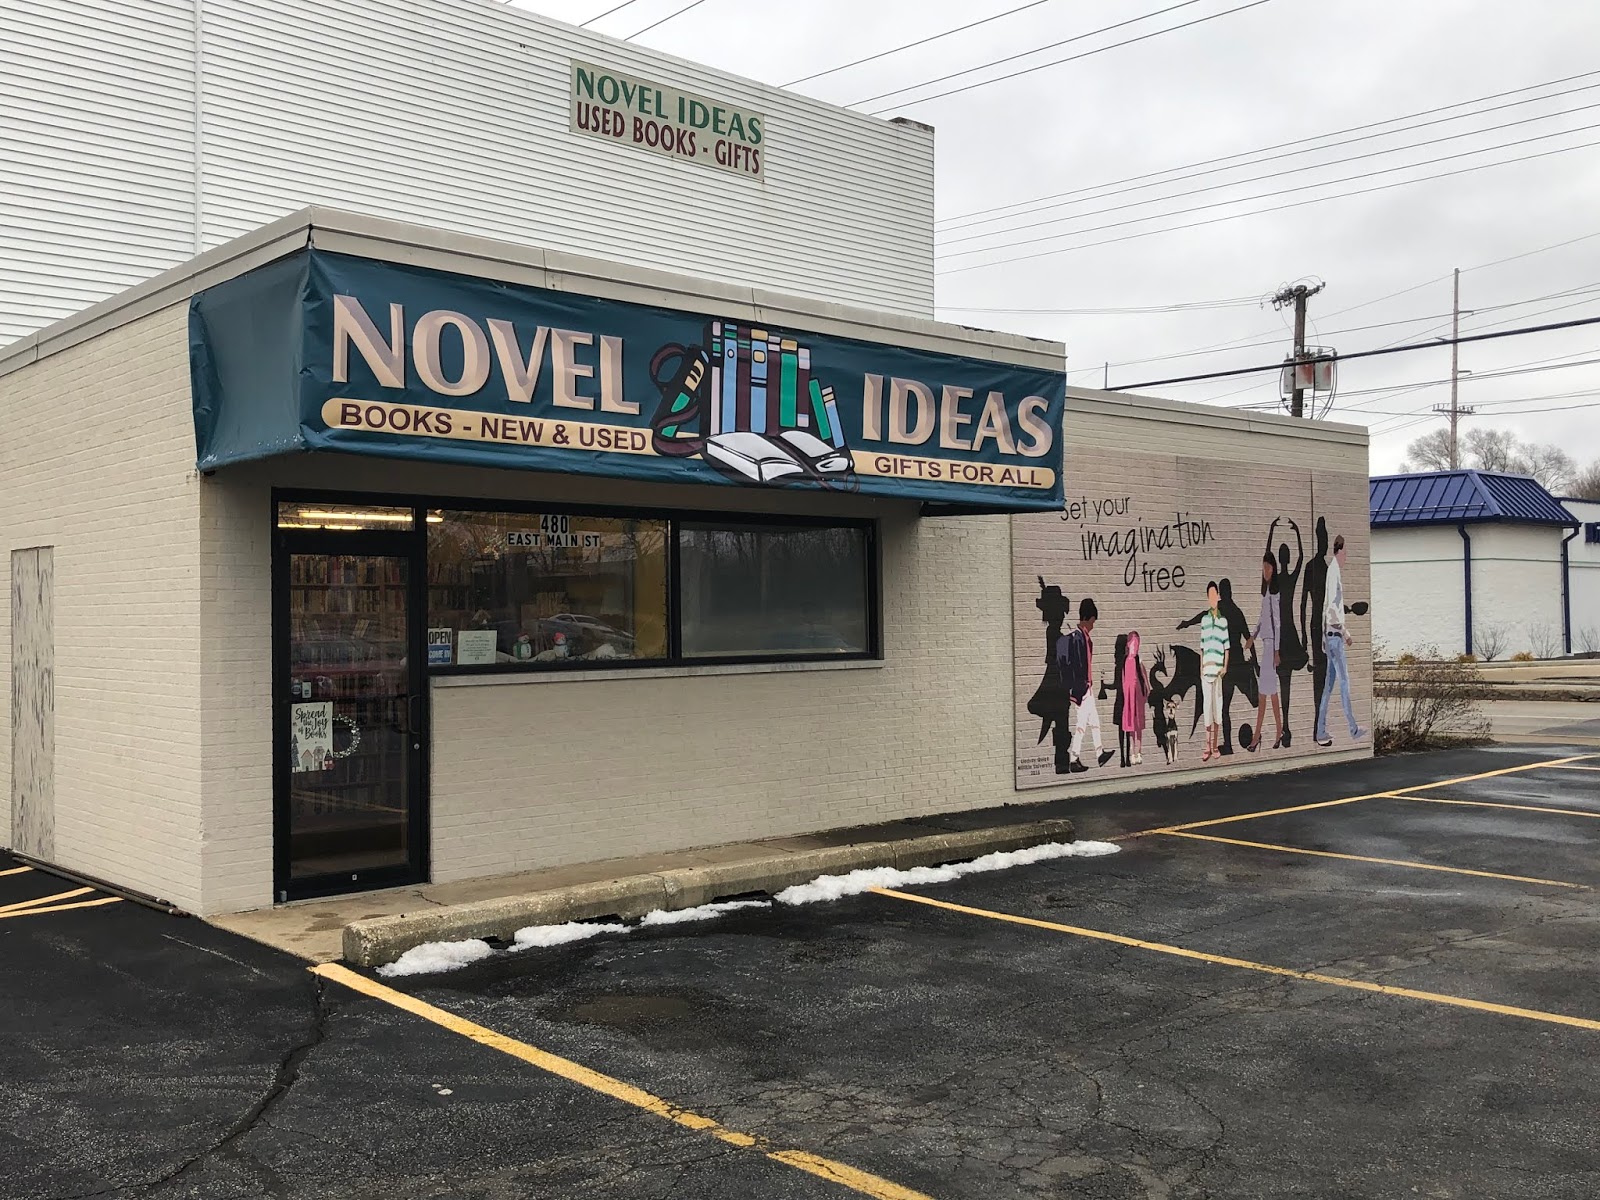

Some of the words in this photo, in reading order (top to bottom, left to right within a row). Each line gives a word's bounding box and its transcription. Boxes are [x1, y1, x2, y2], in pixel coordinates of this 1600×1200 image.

[576, 67, 669, 119] NOVEL
[678, 96, 762, 144] IDEAS
[577, 101, 625, 137] USED
[633, 116, 696, 157] BOOKS
[715, 139, 760, 174] GIFTS
[332, 293, 641, 415] NOVEL
[862, 373, 1053, 457] IDEAS
[340, 403, 452, 434] BOOKS
[480, 417, 544, 443] NEW
[552, 424, 570, 446] &
[579, 427, 647, 451] USED
[875, 456, 942, 478] GIFTS
[950, 464, 995, 483] FOR
[999, 468, 1042, 486] ALL
[541, 515, 568, 533] 480
[1093, 496, 1130, 522] your
[508, 533, 540, 545] EAST
[547, 534, 578, 546] MAIN
[585, 535, 600, 547] ST
[1080, 511, 1215, 586] imagination
[1141, 562, 1185, 592] free
[428, 631, 451, 644] OPEN
